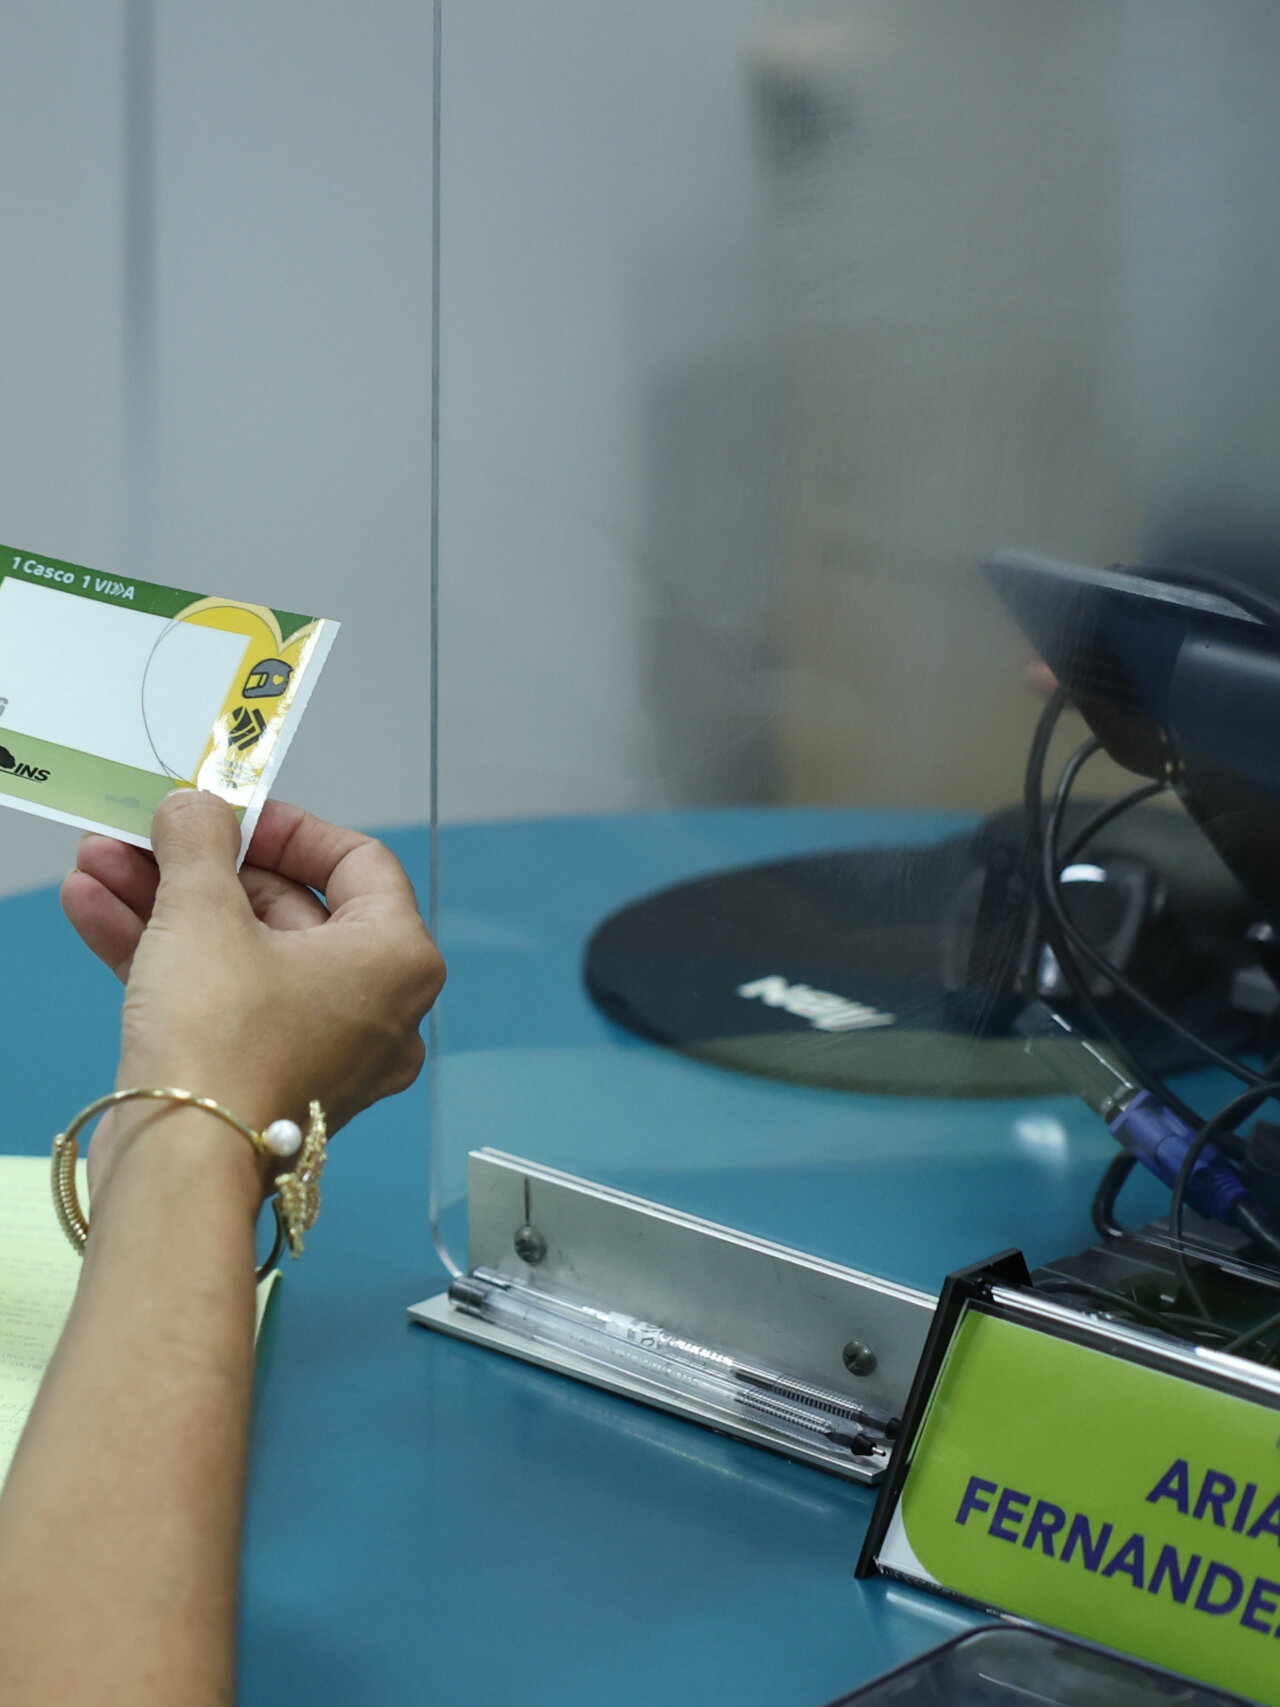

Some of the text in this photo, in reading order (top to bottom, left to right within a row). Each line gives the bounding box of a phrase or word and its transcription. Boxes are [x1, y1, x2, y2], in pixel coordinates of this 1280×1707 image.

[12, 556, 22, 571] 1
[23, 559, 75, 584] Casco
[82, 574, 92, 589] 1
[14, 762, 51, 782] INS
[1145, 1458, 1280, 1548] ARIA
[954, 1475, 1280, 1640] FERNANDE
